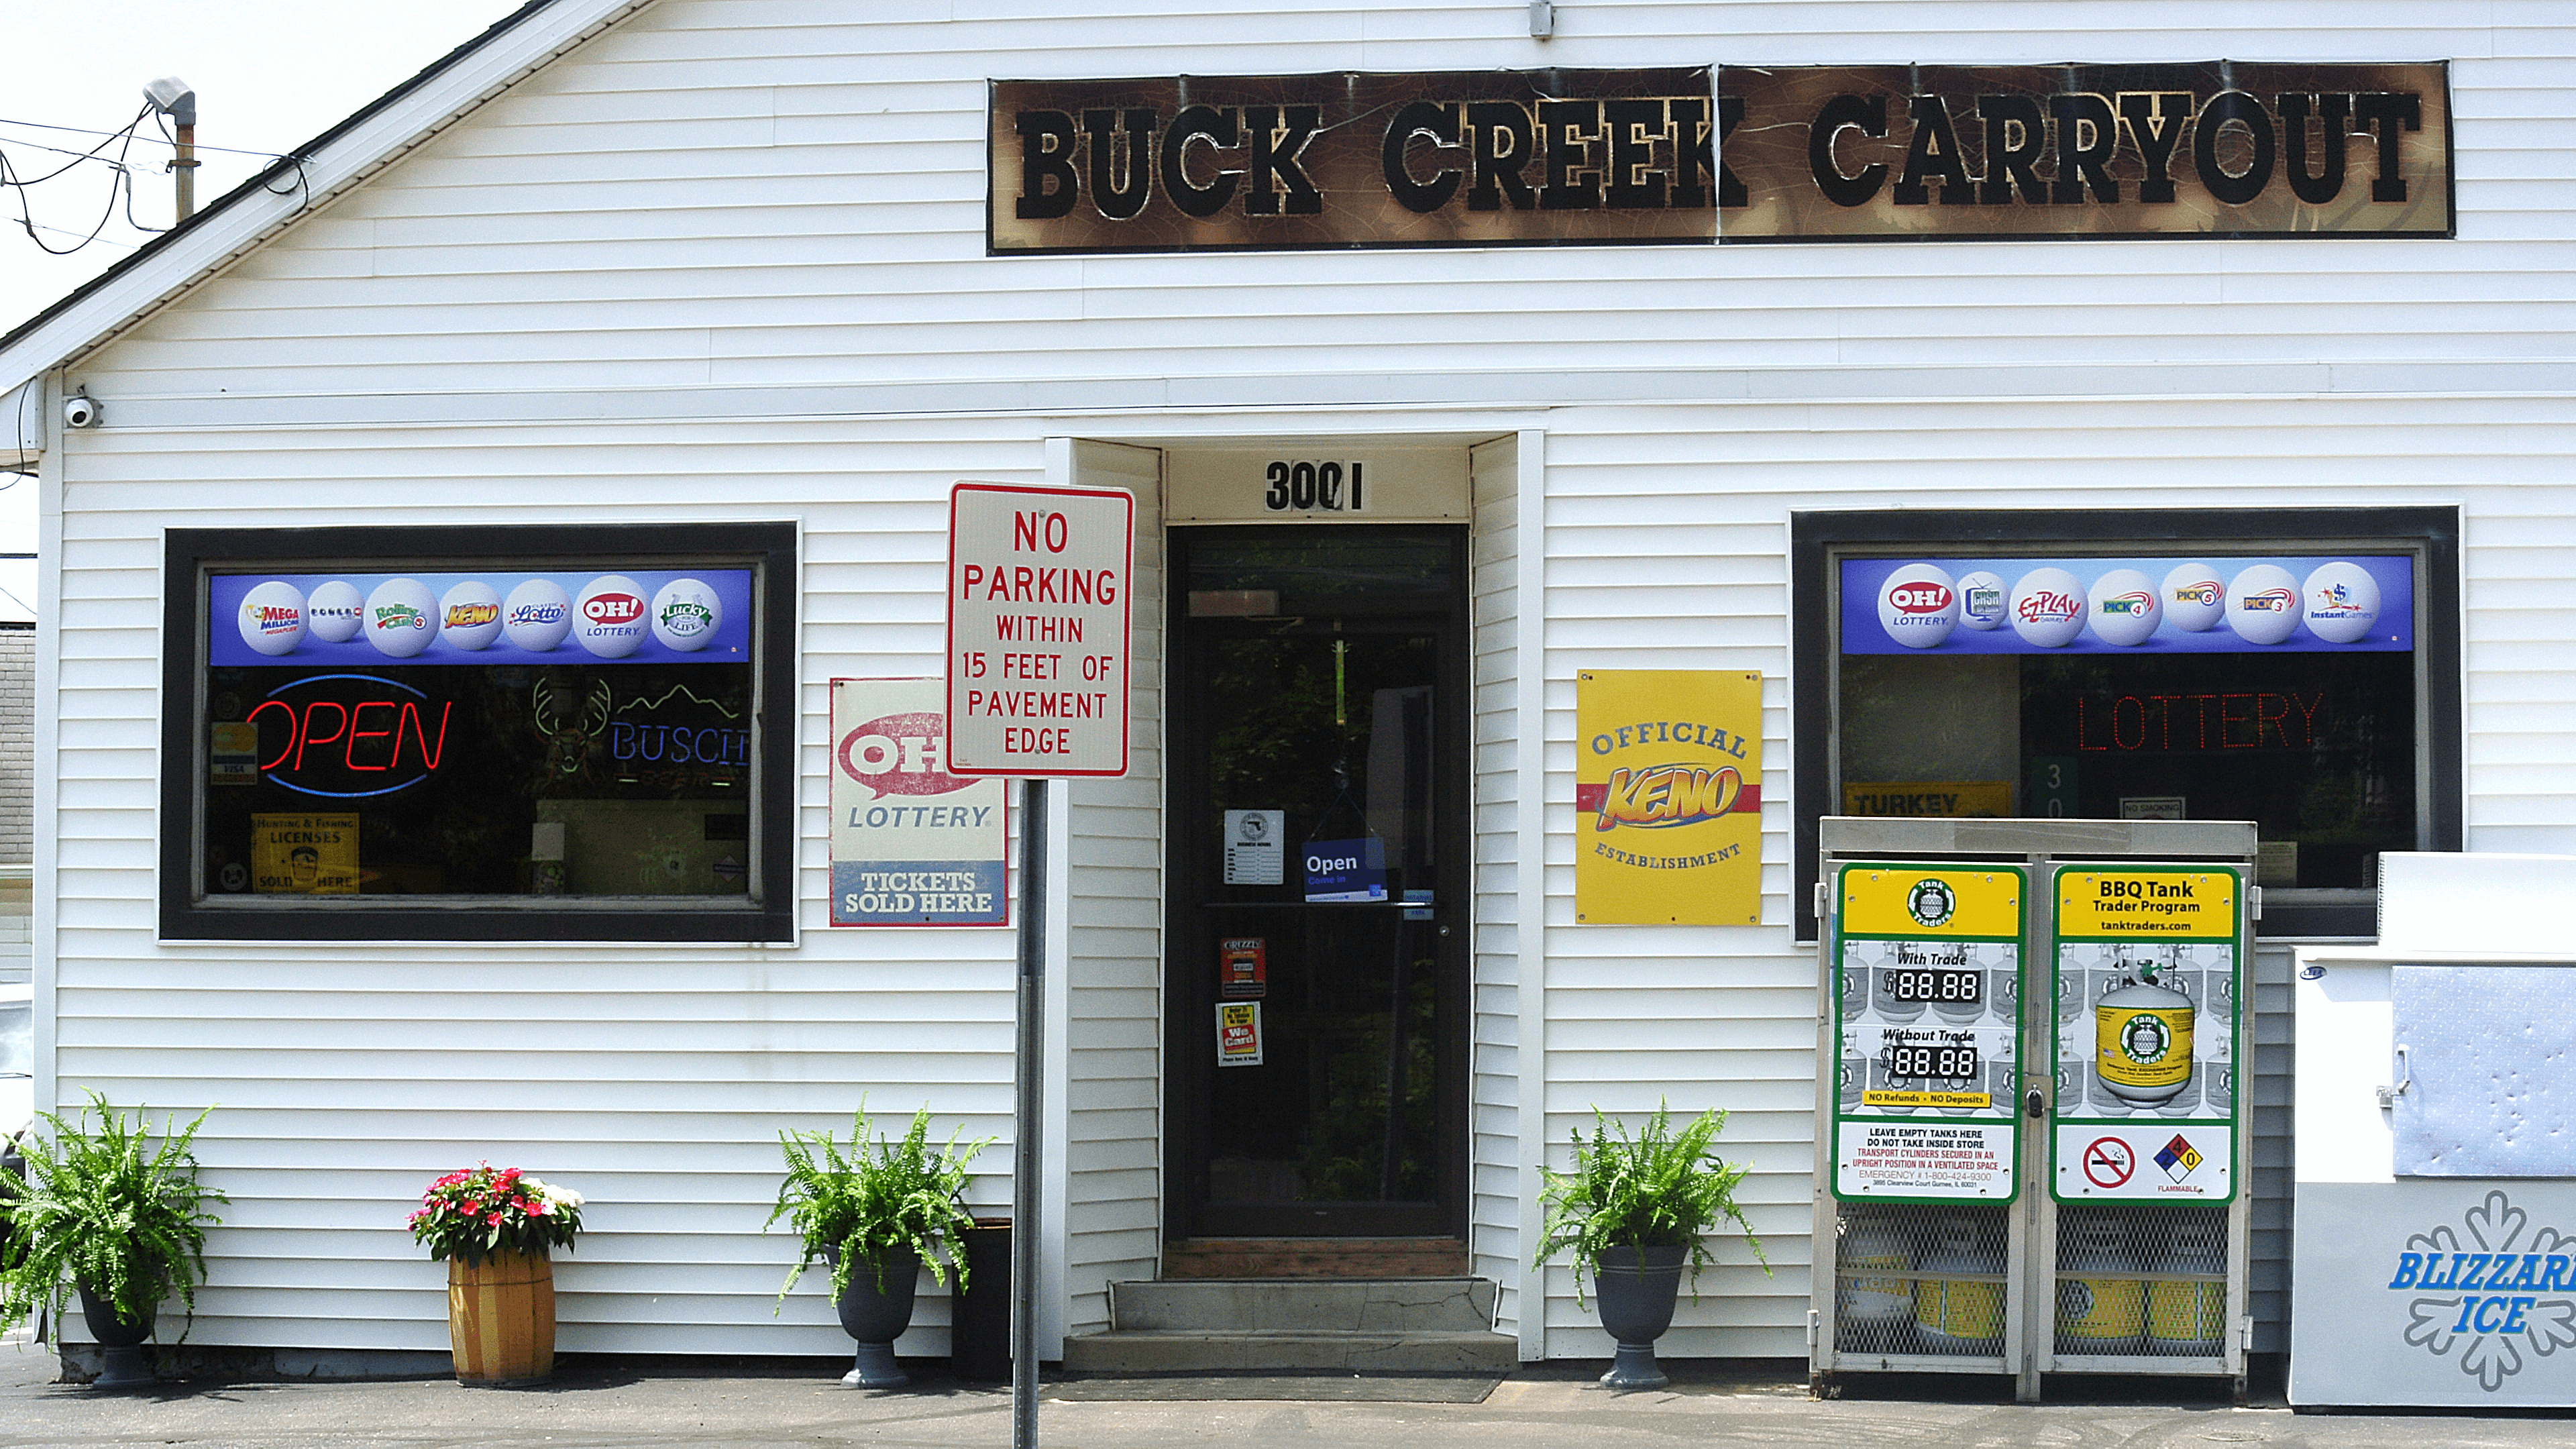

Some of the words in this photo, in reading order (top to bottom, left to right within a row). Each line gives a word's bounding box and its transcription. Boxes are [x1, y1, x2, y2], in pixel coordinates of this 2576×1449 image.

[1016, 104, 1322, 220] BUCK
[1383, 97, 1748, 213] CREEK
[1809, 91, 2421, 207] CARRYOUT
[1267, 462, 1362, 510] 3001
[1014, 511, 1068, 553] NO
[964, 565, 1116, 605] PARKING
[1892, 587, 1946, 607] OH!
[2177, 591, 2201, 601] PICK
[2204, 592, 2212, 603] 5
[586, 598, 639, 618] OH!
[666, 603, 708, 617] Lucky
[2104, 602, 2129, 612] PICK
[2133, 604, 2142, 615] 4
[2245, 598, 2271, 609] PICK
[2274, 601, 2284, 612] 3
[264, 606, 299, 621] MEGA
[445, 604, 498, 629] KENO
[514, 605, 564, 623] Lotto
[1893, 616, 1947, 626] LOTTERY
[587, 627, 639, 637] LOTTERY
[996, 615, 1082, 642] WITHIN
[963, 652, 986, 678] 15
[1004, 653, 1061, 680] FEET
[1083, 655, 1113, 681] OF
[968, 690, 1107, 718] PAVEMENT
[2080, 693, 2324, 750] LOTTERY
[246, 700, 451, 771] OPEN
[1006, 728, 1070, 753] EDGE
[1592, 722, 1747, 759] OFFICIAL
[610, 722, 750, 766] BUSCH
[1595, 767, 1743, 832] KENO
[1854, 794, 1959, 814] TURKEY
[848, 807, 990, 828] LOTTERY
[270, 831, 340, 844] LICENSES
[1595, 842, 1741, 869] ESTABLISHMENT
[1306, 855, 1358, 875] Open
[260, 877, 293, 888] SOLD
[318, 877, 353, 888] HERE
[861, 872, 975, 892] TICKETS
[1308, 875, 1335, 885] Come
[1336, 874, 1346, 883] in
[1918, 879, 1945, 890] Tank
[2100, 881, 2143, 899] BBQ
[2147, 881, 2194, 898] Tank
[846, 893, 914, 913] SOLD
[920, 894, 992, 912] HERE
[2092, 900, 2139, 912] Trader
[2141, 900, 2200, 915] Program
[1913, 911, 1951, 927] Traders
[2100, 922, 2192, 932] tanktraders.com
[1224, 940, 1262, 951] GRIZZLY
[1897, 953, 1926, 965] With
[1929, 953, 1967, 966] Trade
[2131, 1016, 2159, 1025] Tank
[1228, 1027, 1249, 1038] We
[1883, 1028, 1935, 1041] Without
[1939, 1030, 1975, 1041] Trade
[1225, 1034, 1254, 1047] Card
[2127, 1049, 2167, 1065] Traders
[1869, 1093, 1882, 1102] NO
[1884, 1093, 1920, 1103] Refunds
[1930, 1095, 1944, 1104] NO
[1947, 1095, 1984, 1105] Deposits
[1870, 1128, 1896, 1137] LEAVE
[1898, 1129, 1927, 1138] EMPTY
[1930, 1130, 1957, 1138] TANKS
[1960, 1130, 1983, 1139] HERE
[1867, 1138, 1879, 1147] DO
[1882, 1139, 1900, 1148] NOT
[1902, 1139, 1924, 1148] TAKE
[1926, 1140, 1954, 1148] INSIDE
[1956, 1140, 1984, 1149] STORE
[2173, 1140, 2183, 1152] 4
[1858, 1148, 1898, 1158] TRANSPORT
[1900, 1149, 1939, 1159] CYLINDERS
[1941, 1150, 1973, 1159] SECURED
[1975, 1151, 1982, 1159] IN
[2161, 1152, 2171, 1167] 2
[2186, 1152, 2196, 1166] 0
[1853, 1159, 1883, 1168] UPRIGHT
[1884, 1160, 1917, 1169] POSITION
[1919, 1161, 1926, 1169] IN
[1934, 1161, 1975, 1170] VENTILATED
[1976, 1162, 1998, 1171] SPACE
[1859, 1170, 1915, 1179] EMERGENCY
[1925, 1172, 1992, 1181] 1-800-424-9300
[2389, 1251, 2576, 1292] BLIZZAR
[2451, 1295, 2537, 1335] ICE
